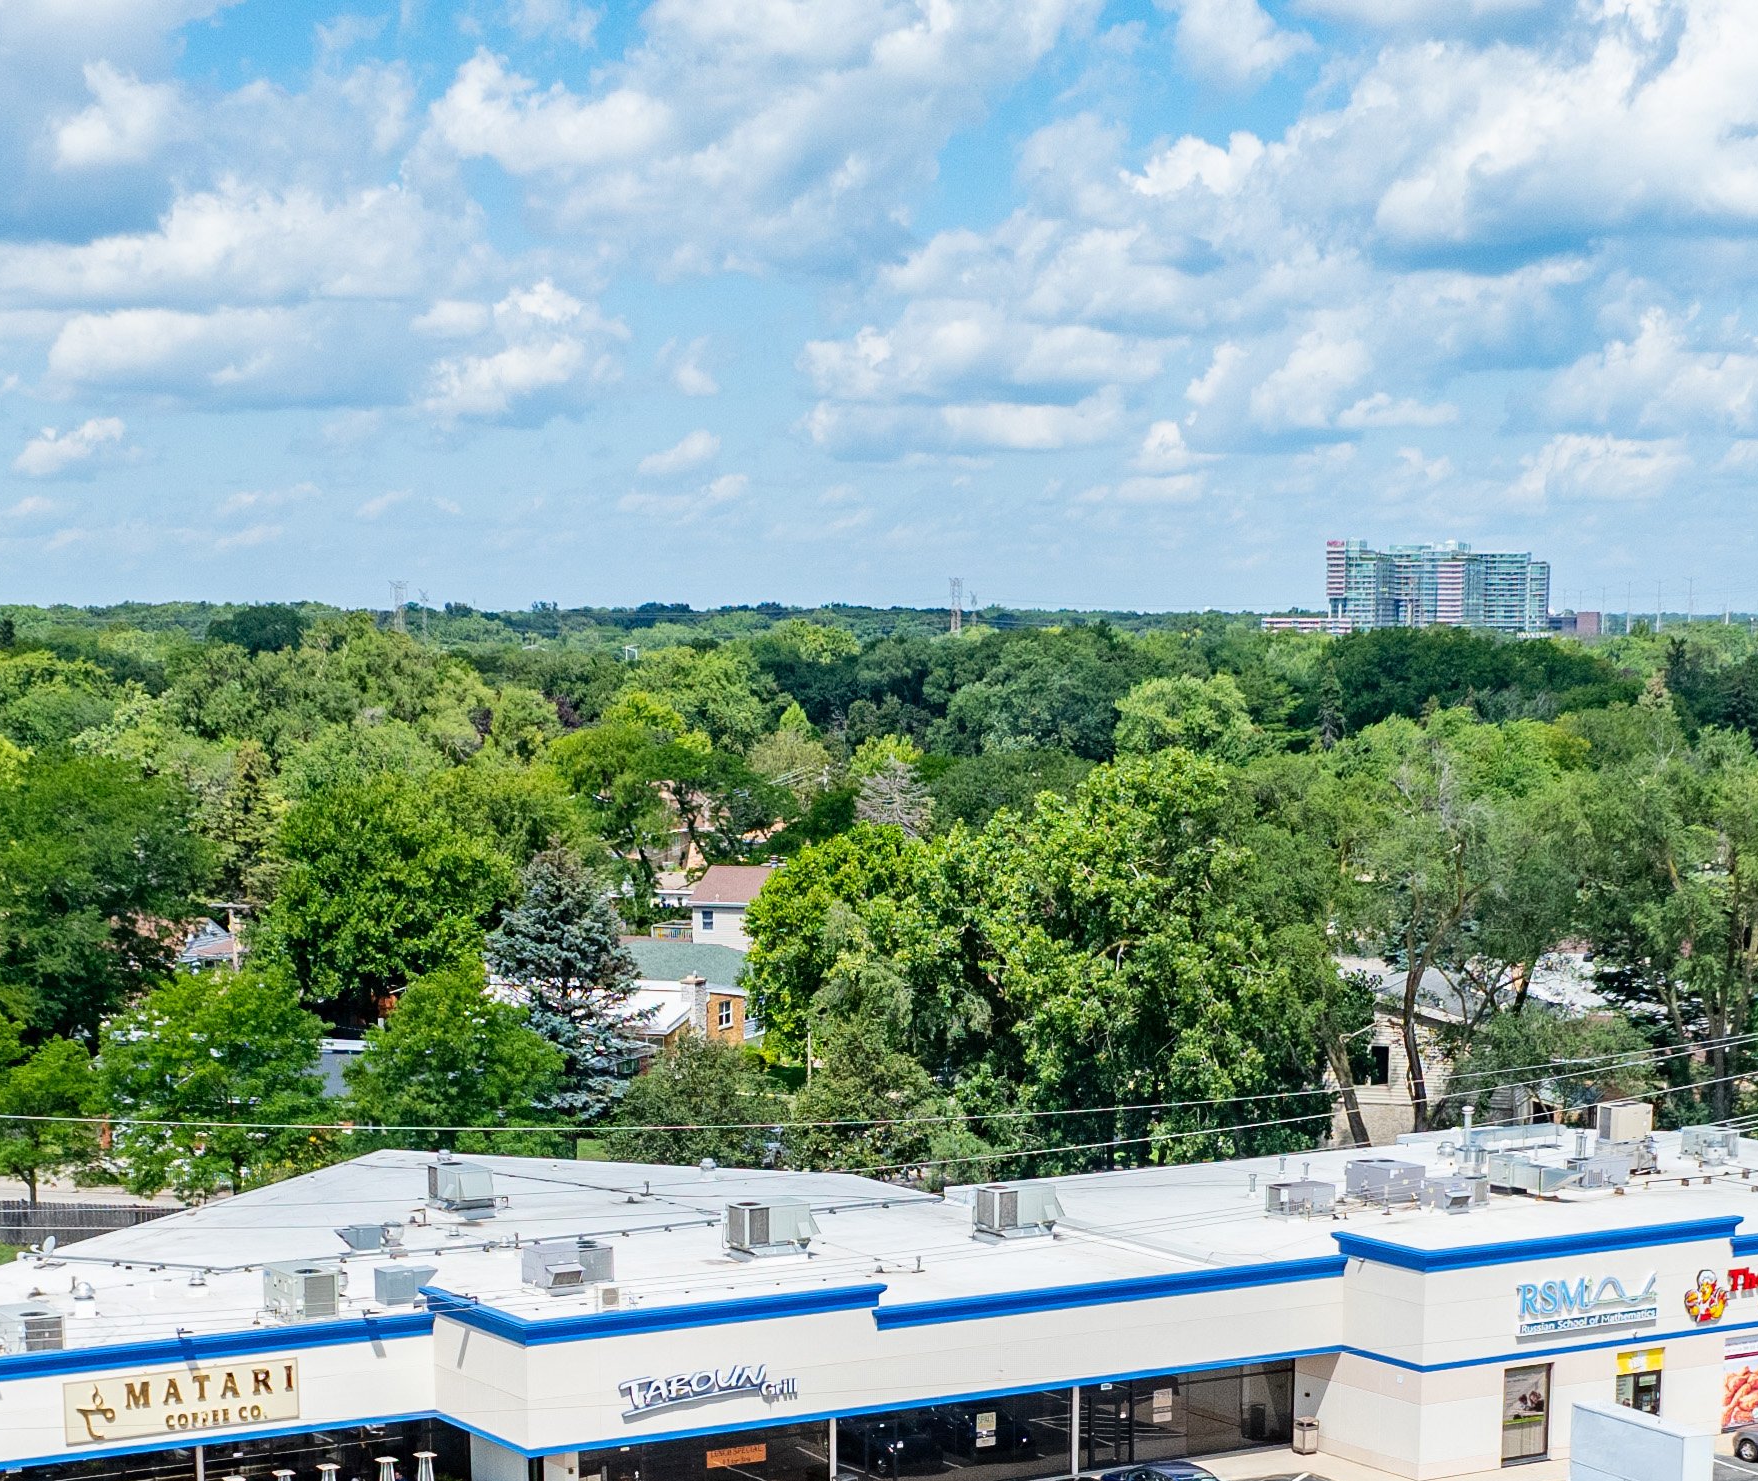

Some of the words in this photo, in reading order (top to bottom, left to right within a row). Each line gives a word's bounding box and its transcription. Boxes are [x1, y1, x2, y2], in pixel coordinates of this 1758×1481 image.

[1518, 1276, 1587, 1316] RSM
[1521, 1322, 1555, 1333] Russian
[1557, 1317, 1587, 1330] School
[1589, 1315, 1599, 1325] of
[1601, 1308, 1656, 1323] Mathematics
[125, 1365, 294, 1410] MATARI
[618, 1364, 766, 1410] TABOUN
[760, 1377, 799, 1397] Grill
[166, 1408, 230, 1430] COFFEE
